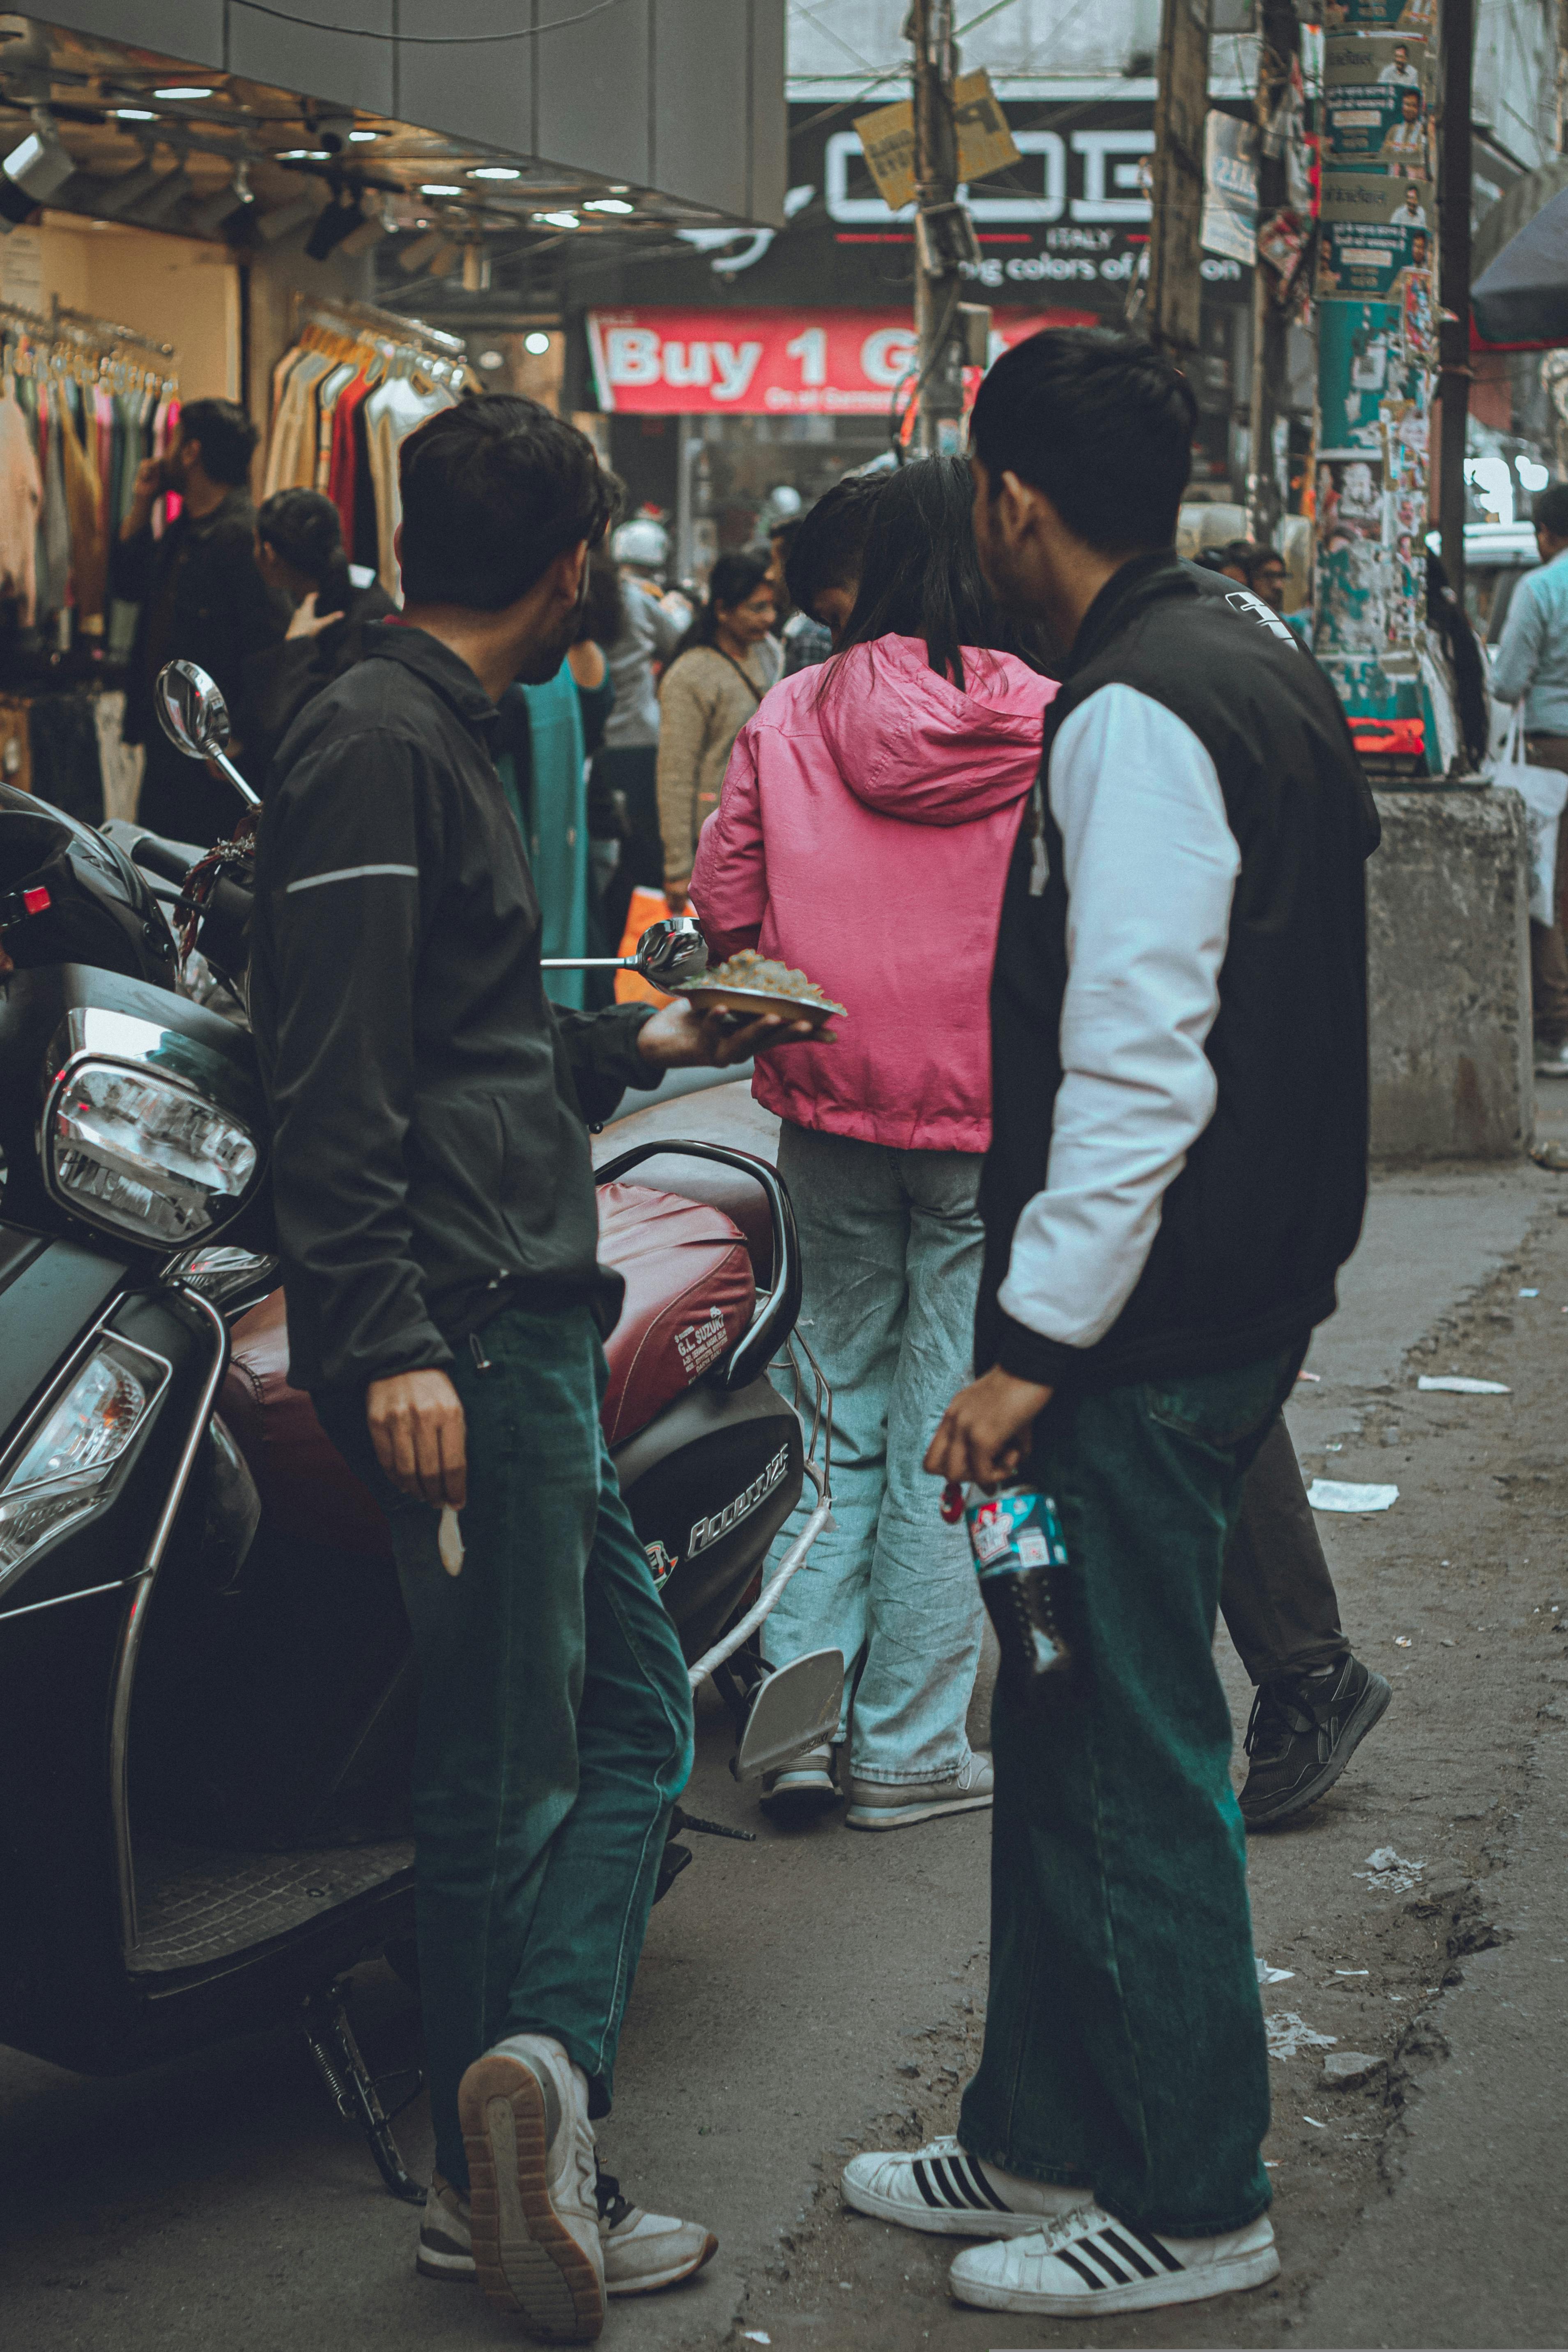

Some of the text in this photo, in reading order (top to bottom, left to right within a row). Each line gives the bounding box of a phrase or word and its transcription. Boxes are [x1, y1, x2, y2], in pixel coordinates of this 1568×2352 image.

[1046, 228, 1115, 250] ITALY
[1005, 251, 1098, 281] colors
[1100, 251, 1135, 281] of
[606, 327, 763, 402] Buy
[786, 327, 828, 387] 1
[695, 1314, 724, 1345] SUZUKI
